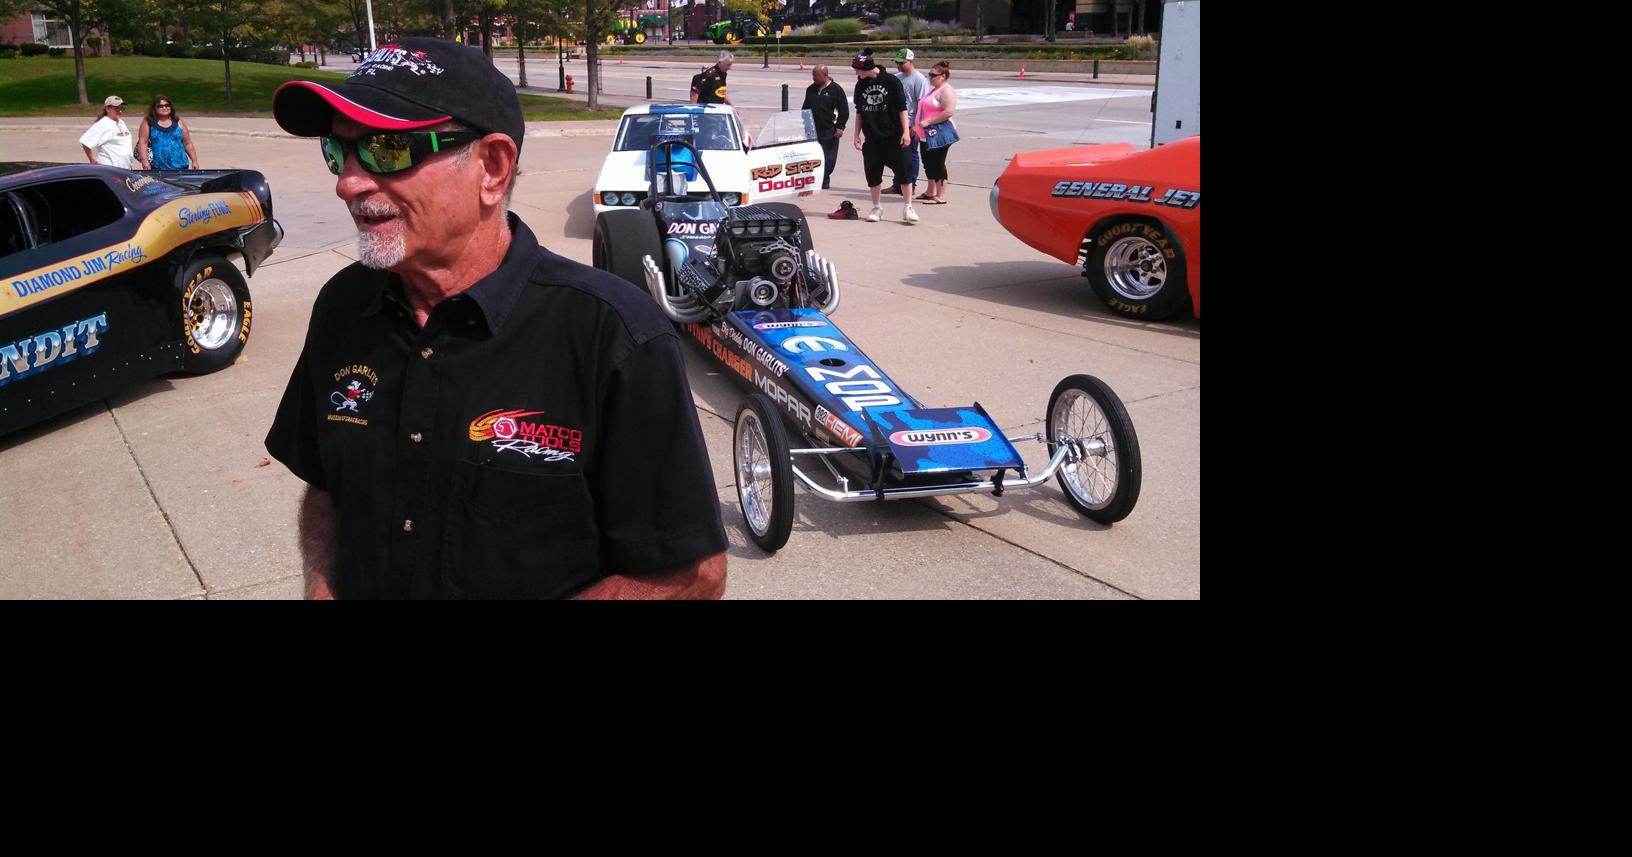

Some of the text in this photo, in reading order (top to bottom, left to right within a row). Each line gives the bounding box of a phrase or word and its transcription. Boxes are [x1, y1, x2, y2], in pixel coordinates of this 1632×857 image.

[759, 176, 815, 192] Dodge
[1051, 181, 1200, 209] GENERAL JET
[179, 207, 211, 228] Sterling
[667, 222, 697, 235] DON
[11, 244, 147, 298] DIAMOND JIM Racing
[1110, 298, 1147, 314] EAGLE
[238, 300, 252, 343] EAGLE
[0, 312, 107, 380] NDIT
[743, 337, 758, 357] DON
[334, 364, 378, 386] DON GARLITS
[755, 369, 811, 427] MOPAR
[804, 365, 900, 414] MOP
[519, 421, 583, 441] MATCO
[824, 412, 863, 447] HEMI
[491, 438, 575, 462] Racing
[520, 434, 582, 453] TOOLS
